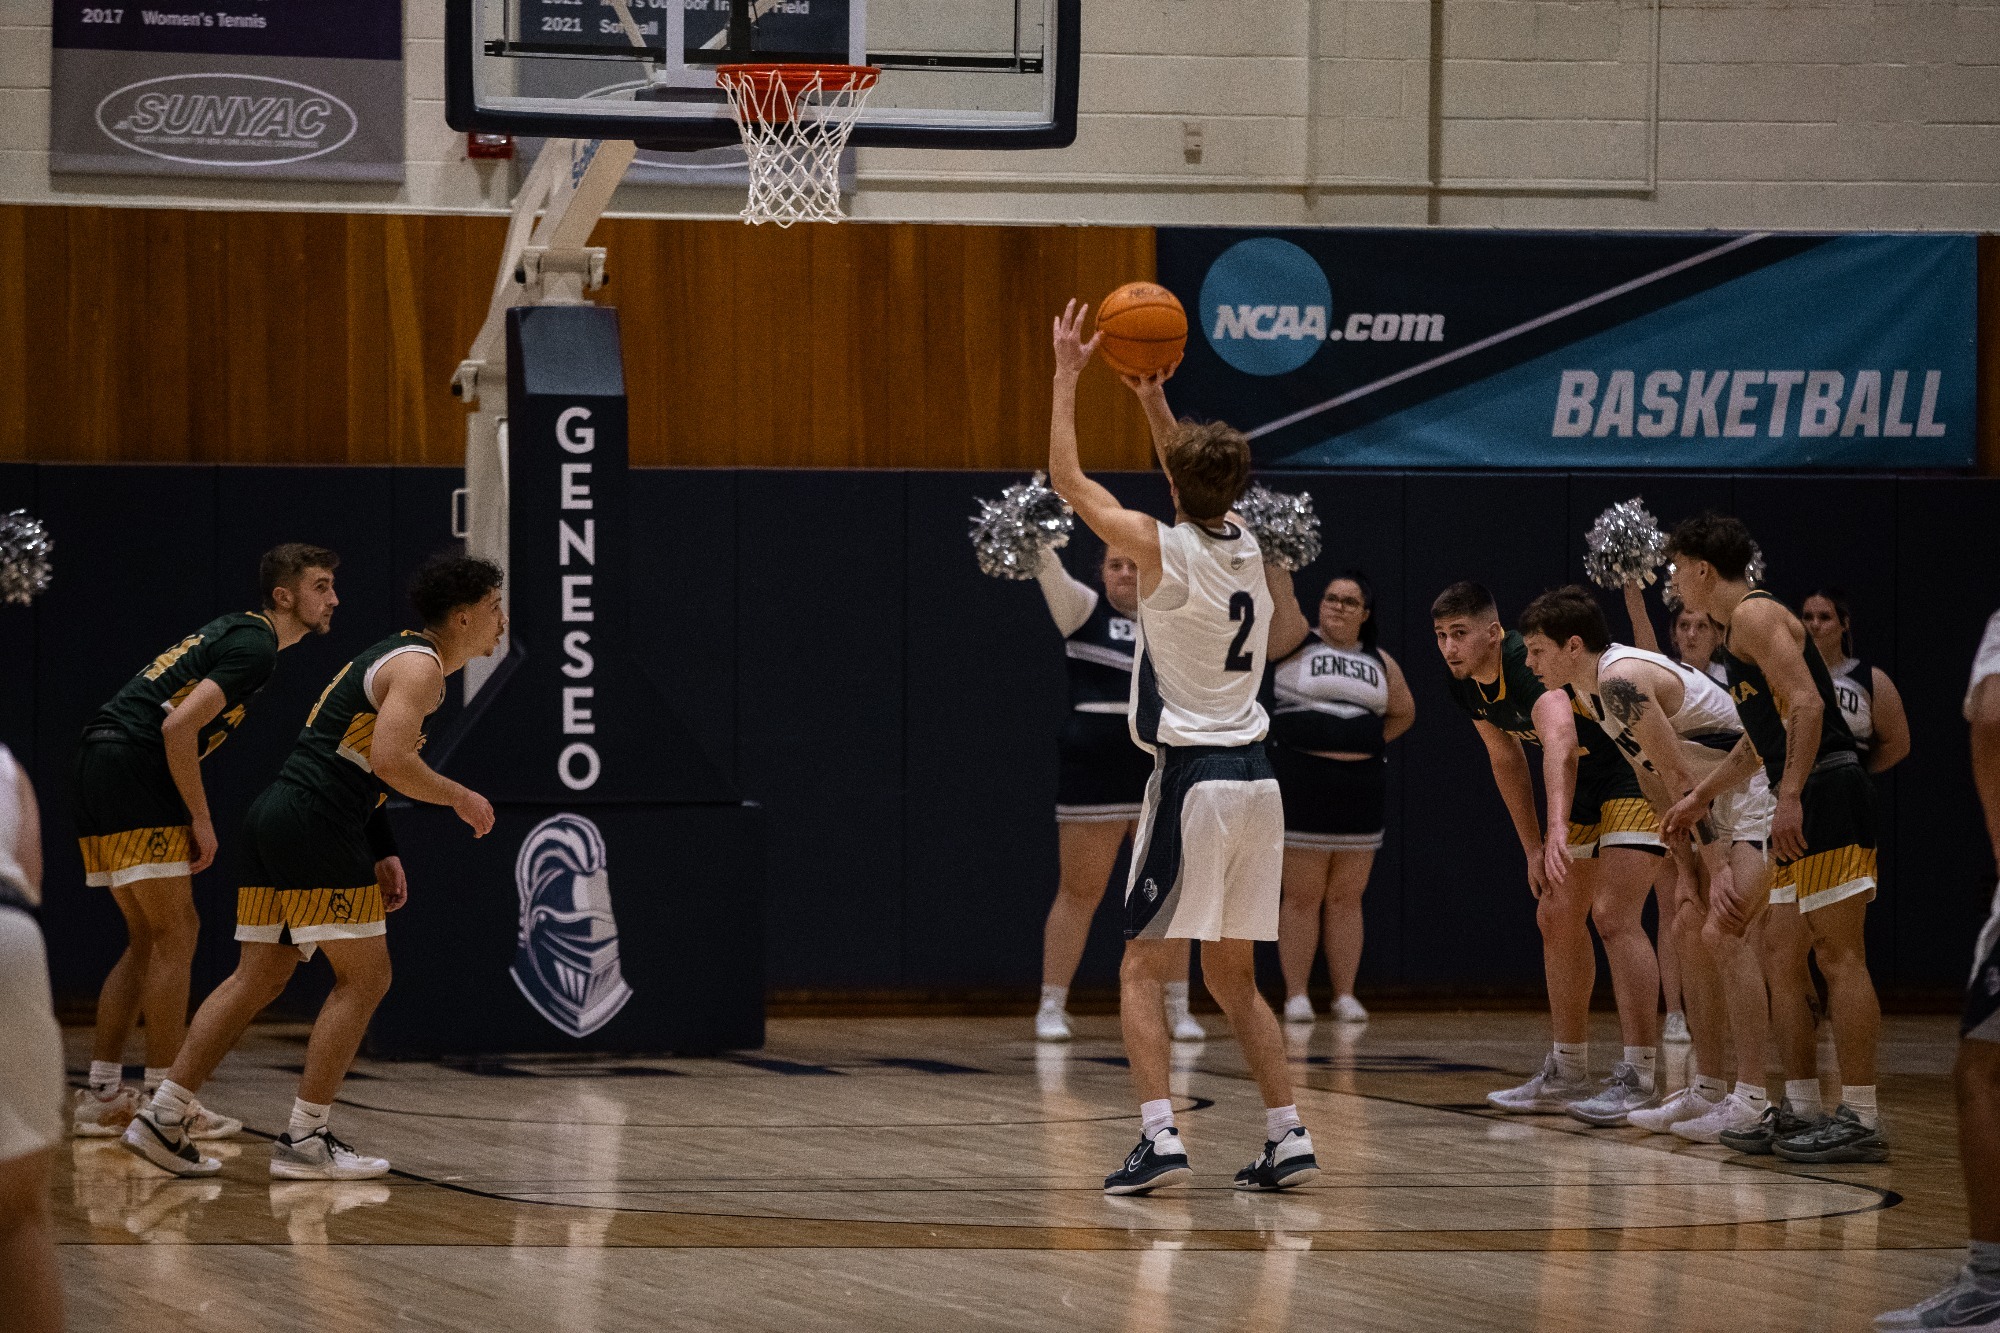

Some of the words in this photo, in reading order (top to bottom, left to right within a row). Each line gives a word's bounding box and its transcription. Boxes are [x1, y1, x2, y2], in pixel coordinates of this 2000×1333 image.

[81, 8, 124, 24] 2017
[141, 10, 214, 27] Women's
[216, 12, 267, 29] Tennis
[541, 16, 583, 32] 2021
[599, 19, 659, 35] Soall
[128, 92, 332, 139] SUNYAC
[1213, 304, 1446, 342] NCAA.com
[1552, 370, 1947, 438] BASKETBALL
[555, 406, 601, 791] GENESEO
[1224, 590, 1255, 672] 2
[1311, 654, 1379, 689] GENESEO
